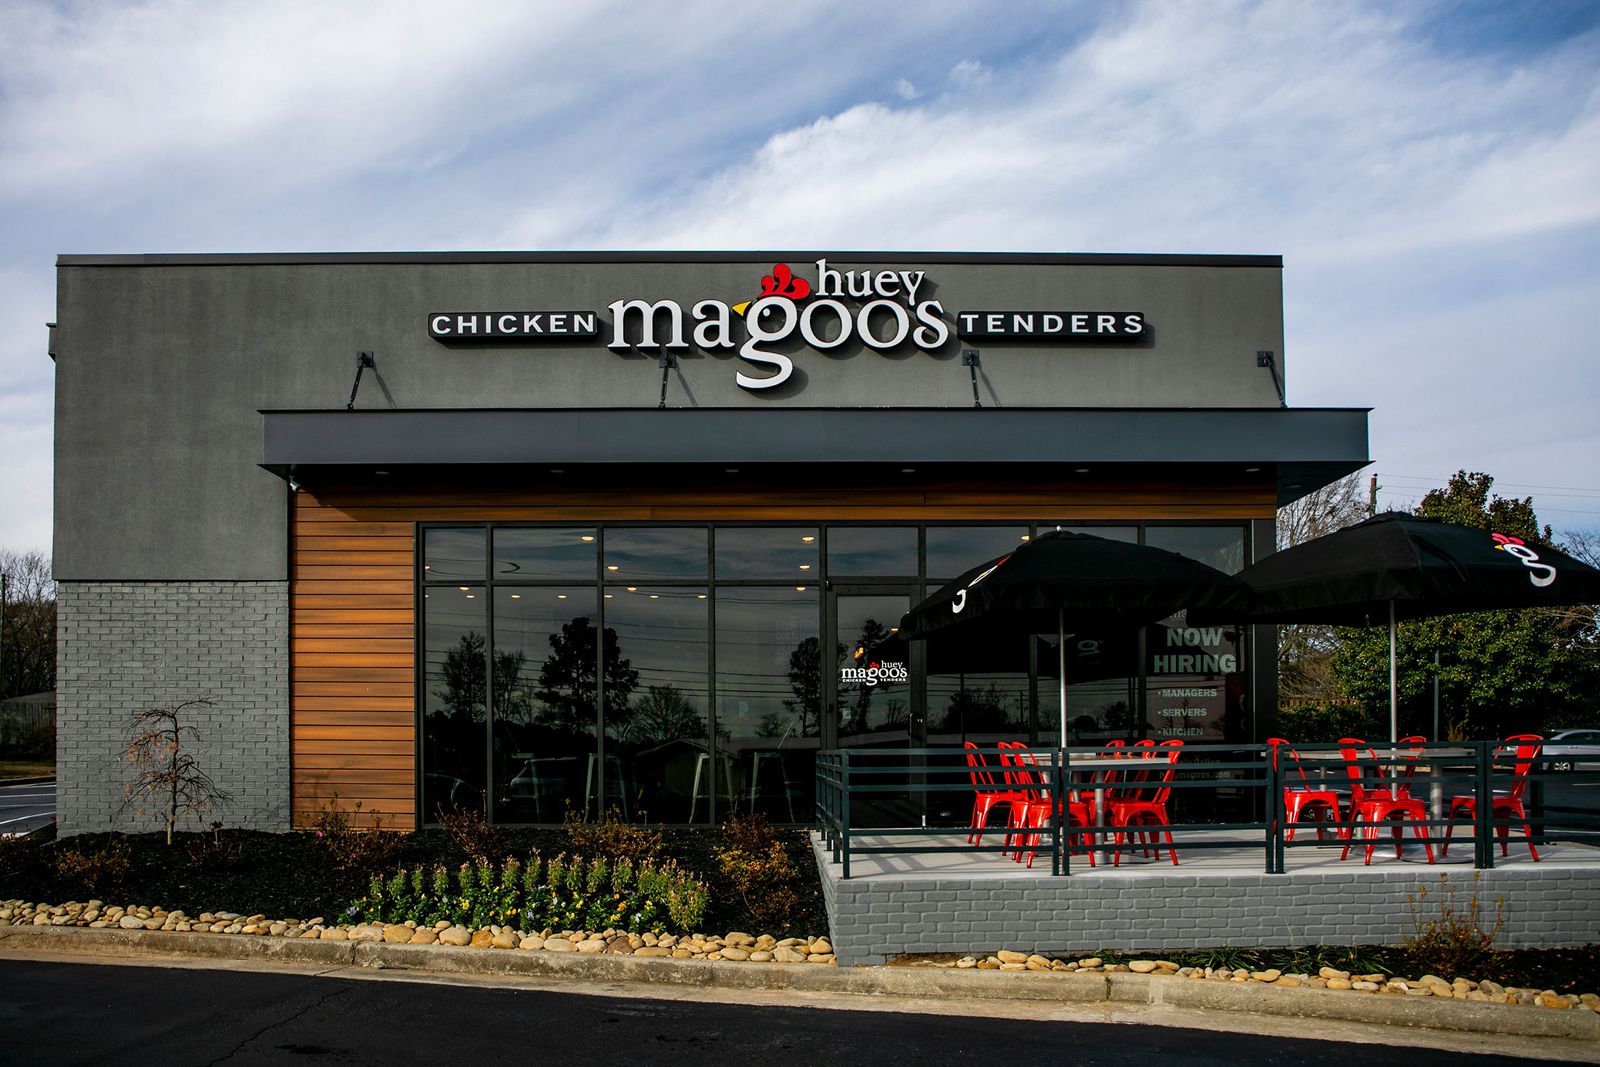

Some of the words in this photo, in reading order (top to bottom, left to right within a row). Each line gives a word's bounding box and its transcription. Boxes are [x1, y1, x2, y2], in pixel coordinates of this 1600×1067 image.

[816, 259, 927, 307] huey
[431, 313, 596, 336] CHICKEN
[961, 312, 1144, 334] TENDERS
[608, 295, 950, 391] magoos
[1167, 628, 1223, 647] NOW
[881, 660, 903, 670] huey
[1153, 654, 1236, 673] HIRING
[841, 667, 908, 686] magoos
[1162, 688, 1217, 697] MANAGERS
[1162, 708, 1207, 717] SERVERS
[1162, 728, 1203, 736] KITCHEN
